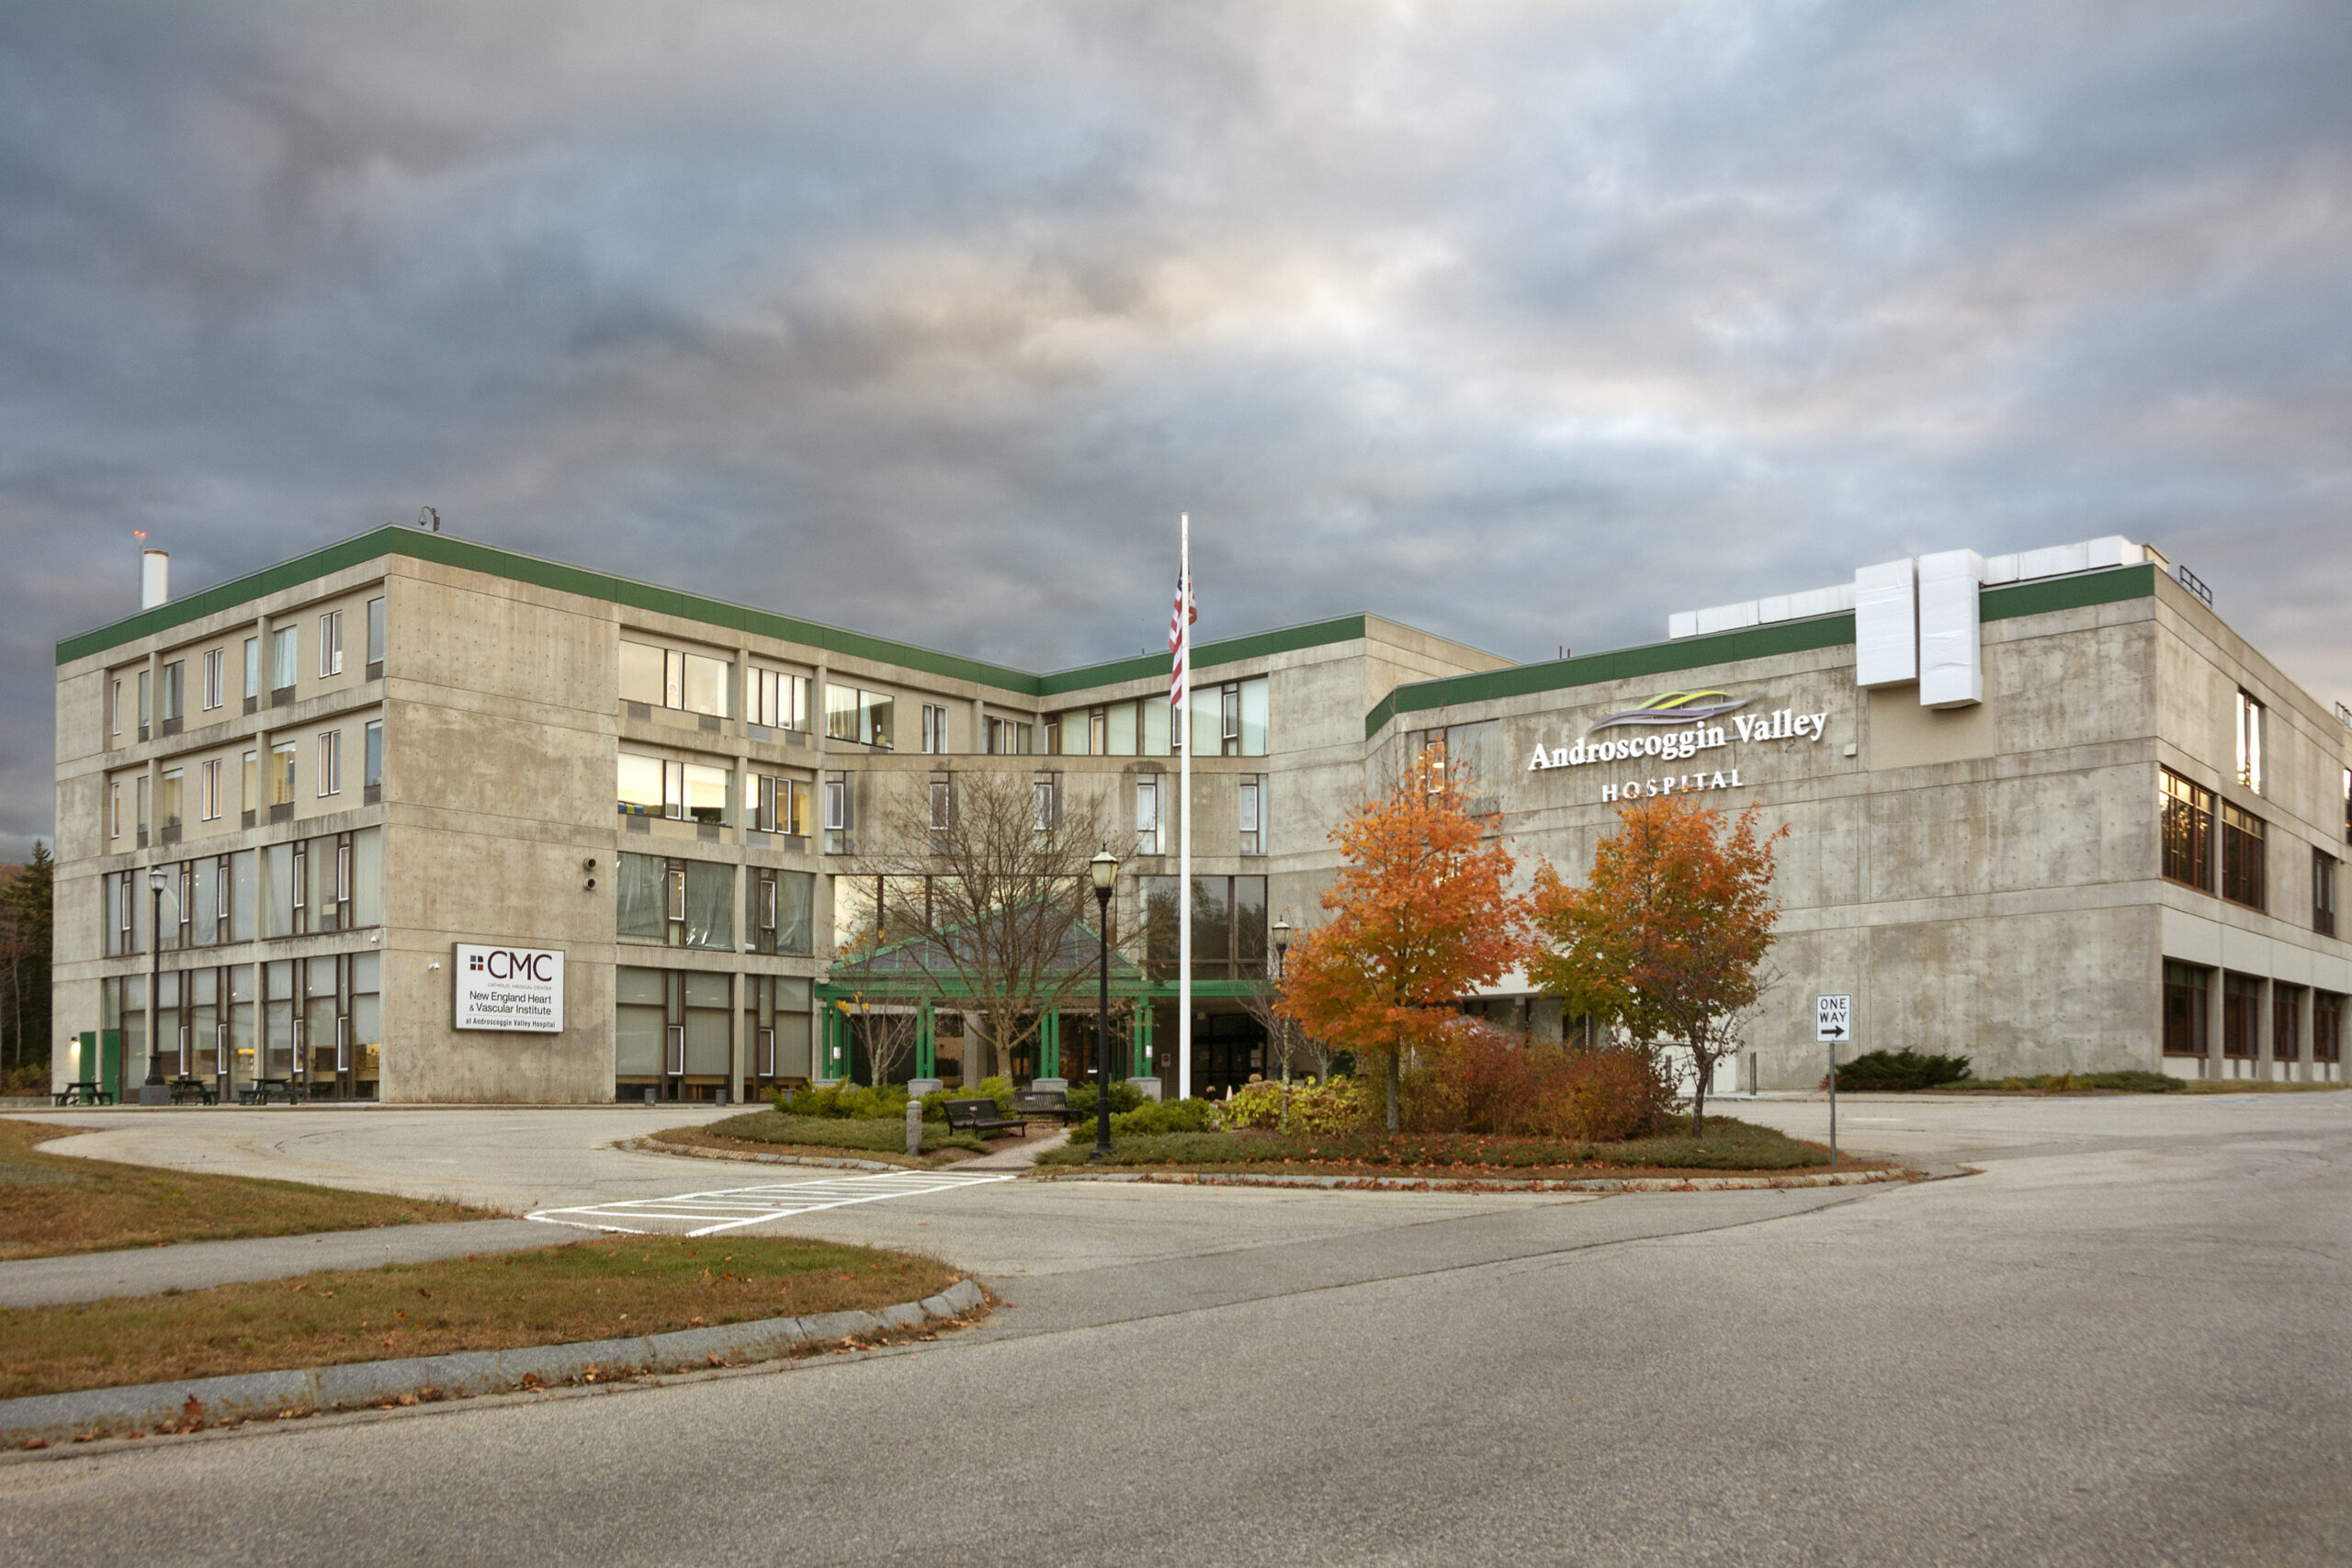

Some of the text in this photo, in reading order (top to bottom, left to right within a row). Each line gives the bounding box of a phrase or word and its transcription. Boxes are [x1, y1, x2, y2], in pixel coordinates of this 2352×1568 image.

[1528, 708, 1827, 771] Androscoggin Valley
[1601, 769, 1744, 803] HOSPITAL
[488, 951, 552, 982] CMC
[469, 991, 551, 1004] New England Heart
[476, 1003, 514, 1013] Vascular
[516, 1005, 551, 1015] Institute
[1820, 998, 1847, 1010] ONE
[1820, 1011, 1847, 1022] WAY
[473, 1018, 512, 1027] Androscoggin
[514, 1020, 530, 1028] Valley
